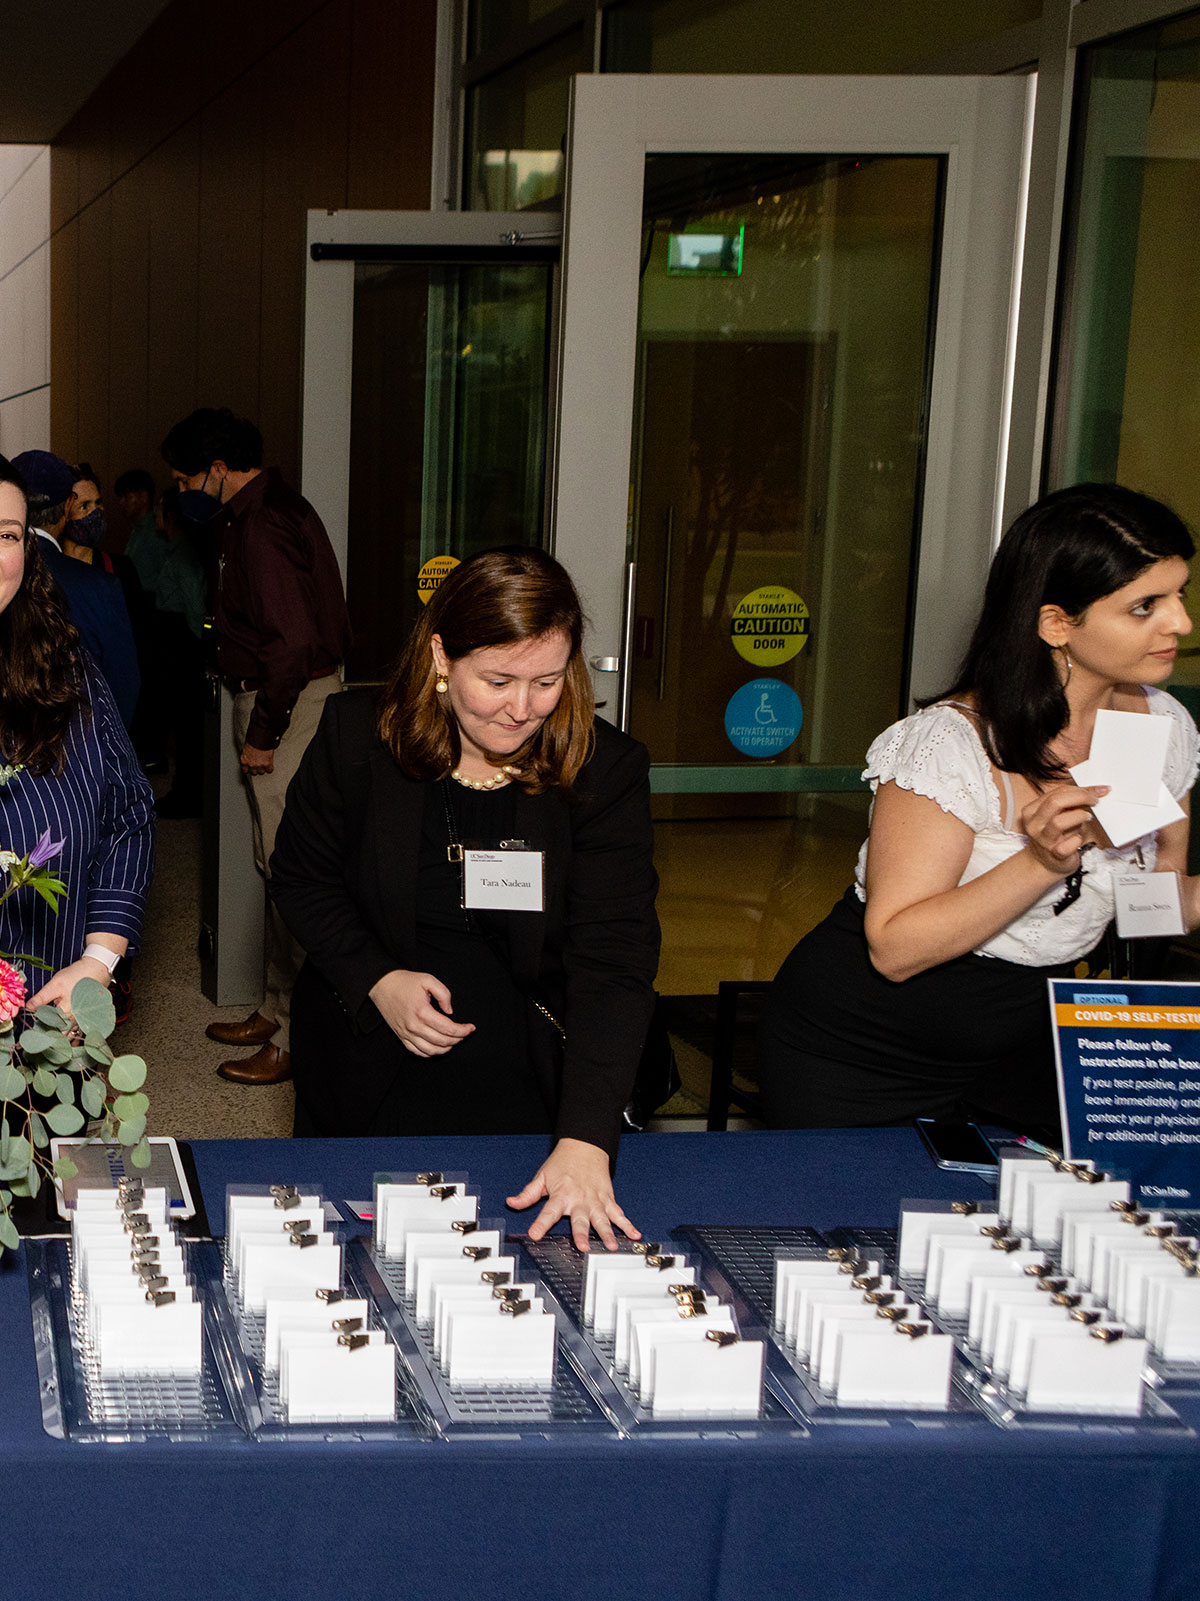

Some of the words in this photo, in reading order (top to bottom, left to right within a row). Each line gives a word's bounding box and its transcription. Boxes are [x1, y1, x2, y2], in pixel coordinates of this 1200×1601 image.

[739, 604, 804, 614] AUTOMATIC
[734, 619, 805, 633] CAUTION
[754, 639, 785, 649] DOOR
[731, 727, 764, 736] ACTIVATE
[766, 727, 795, 736] SWITCH
[741, 737, 749, 745] TO
[751, 737, 783, 746] OPERATE
[501, 879, 531, 887] Nadeau
[1080, 996, 1123, 1004] OPTIONAL
[1075, 1010, 1131, 1022] COVID-19
[1077, 1038, 1115, 1050] Please
[1115, 1039, 1151, 1051] follow
[1151, 1040, 1172, 1052] the
[1079, 1055, 1145, 1069] instructions
[1145, 1057, 1158, 1069] in
[1158, 1057, 1178, 1070] the
[1083, 1076, 1091, 1090] If
[1092, 1079, 1112, 1090] you
[1114, 1078, 1134, 1089] test
[1135, 1078, 1178, 1091] positive,
[1085, 1094, 1113, 1106] leave
[1114, 1094, 1179, 1110] immediately
[1180, 1097, 1200, 1108] and
[1086, 1113, 1127, 1124] contact
[1128, 1115, 1153, 1126] your
[1088, 1128, 1104, 1143] for
[1105, 1130, 1159, 1142] additional
